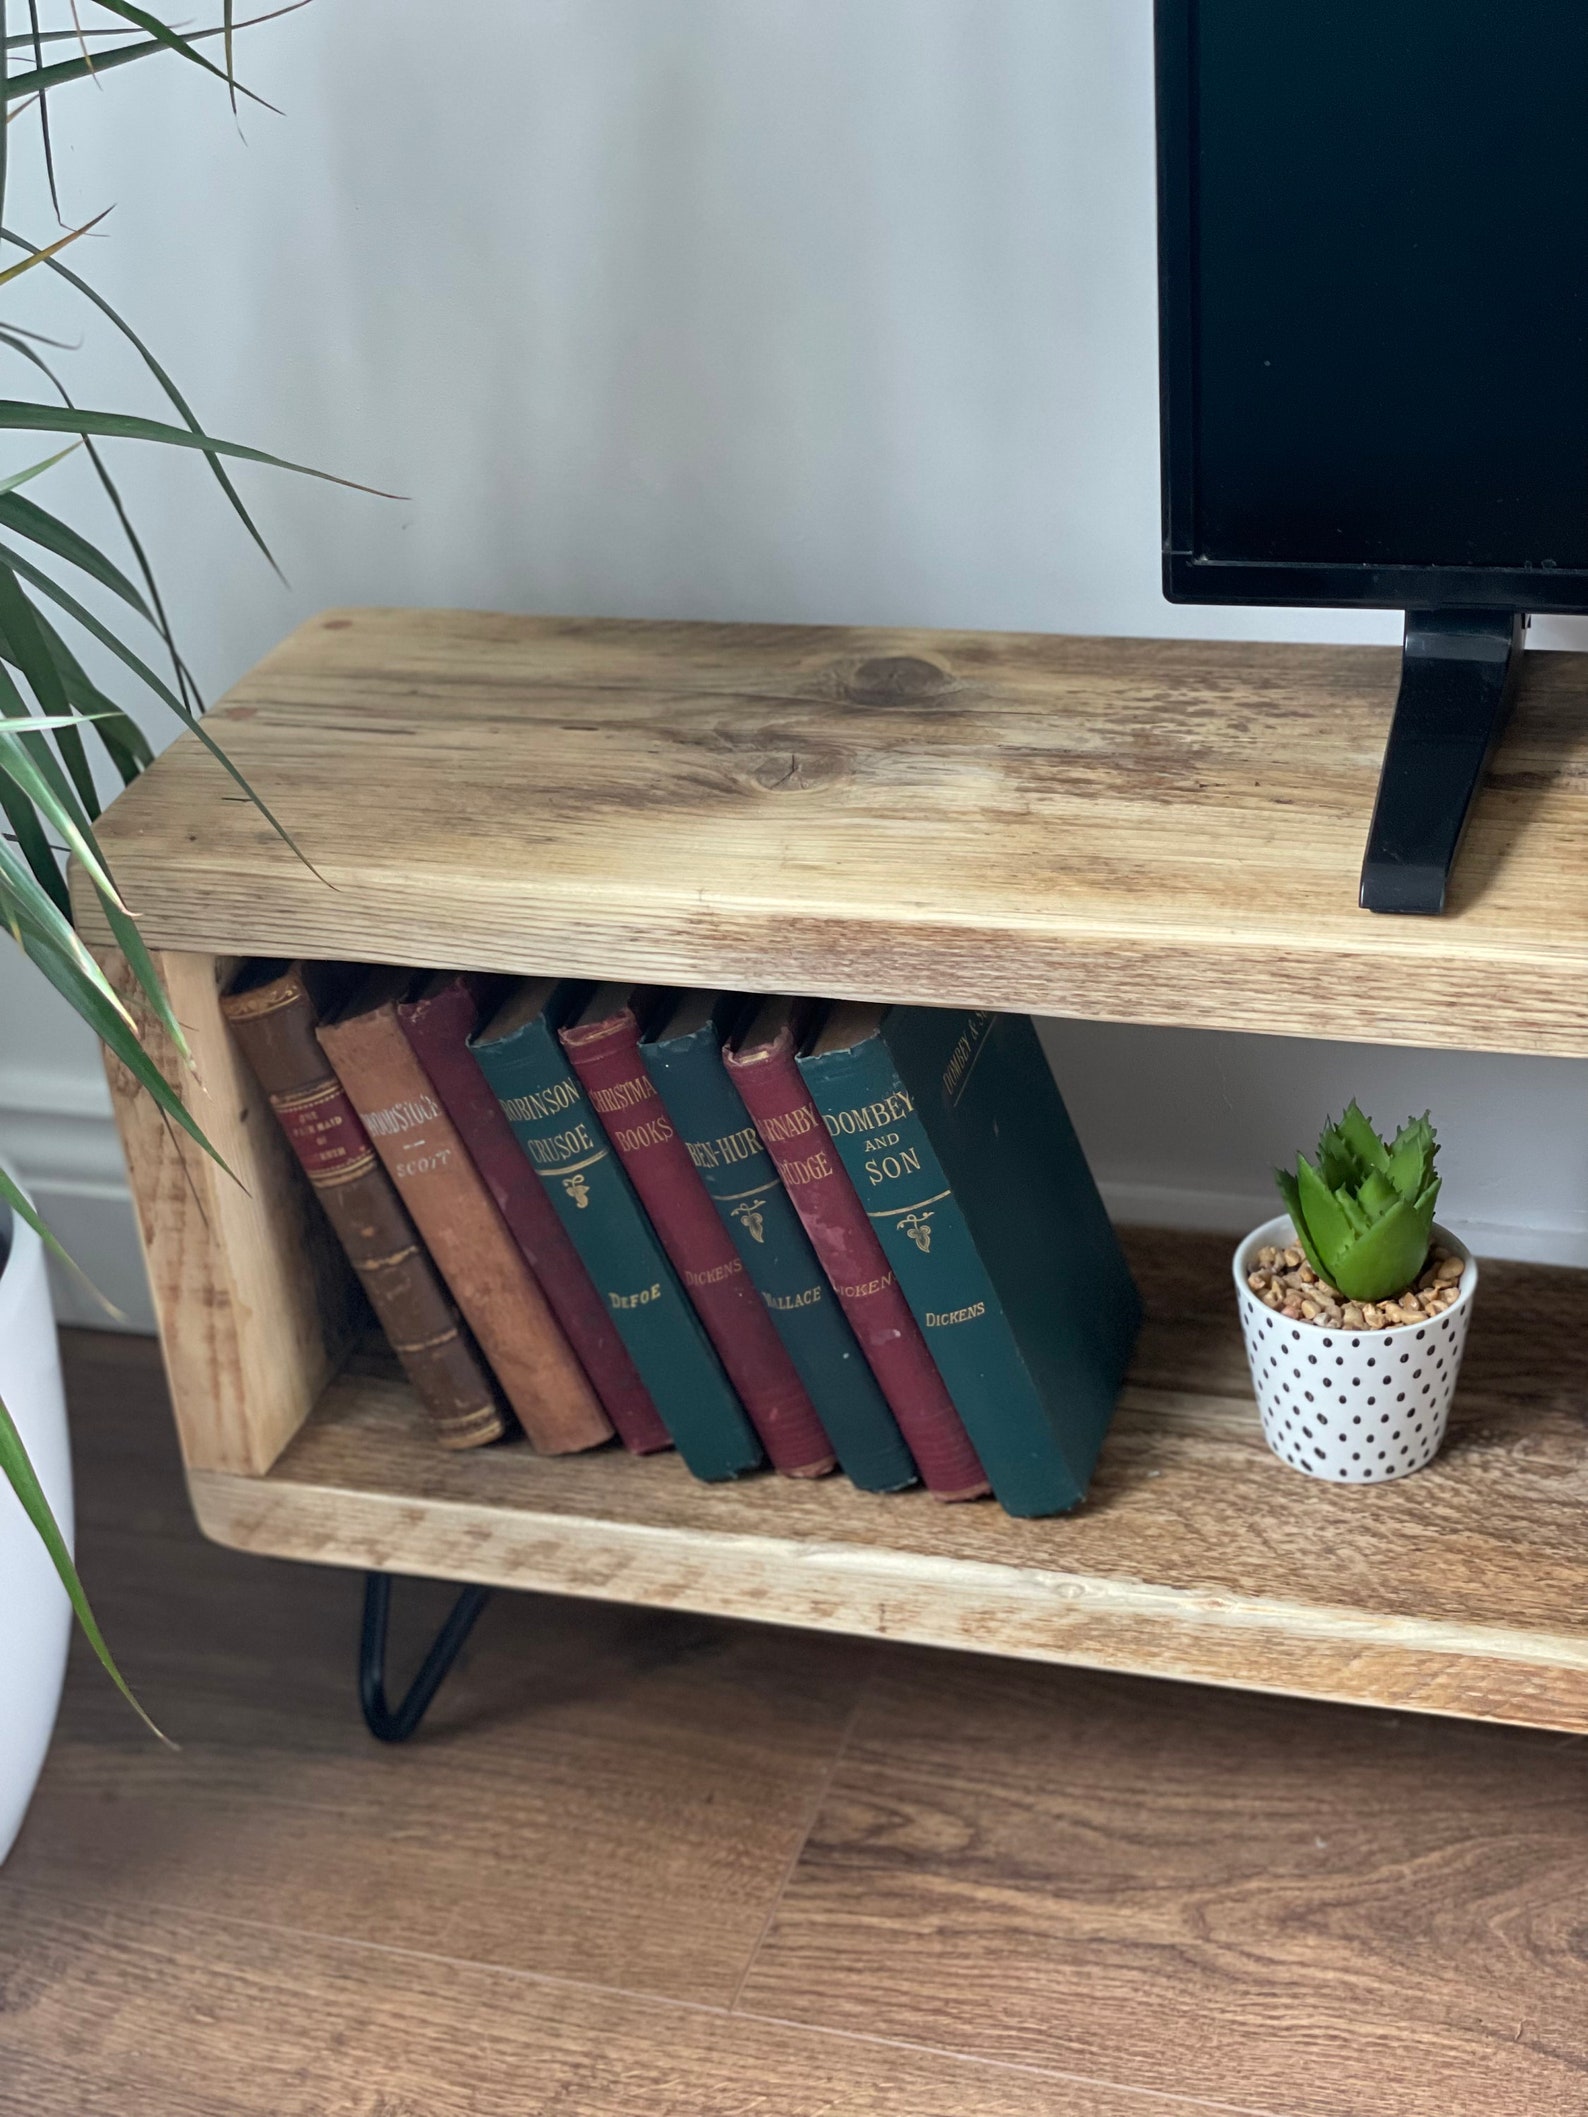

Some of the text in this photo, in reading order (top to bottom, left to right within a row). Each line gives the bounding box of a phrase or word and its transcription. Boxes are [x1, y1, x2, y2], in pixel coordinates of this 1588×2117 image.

[943, 1029, 971, 1095] DOMBEY
[498, 1076, 580, 1121] ROBINSON
[588, 1075, 657, 1113] CHRISTMA
[822, 1088, 914, 1136] DOMBEY
[615, 1115, 673, 1152] BOOKS
[757, 1103, 818, 1142] RNABY
[527, 1123, 594, 1163] CRUSOE
[685, 1127, 764, 1168] BEN-HUR
[864, 1132, 900, 1153] AND
[396, 1149, 451, 1178] SCOTT
[779, 1152, 833, 1185] RUDGE
[865, 1147, 921, 1186] SON
[685, 1258, 743, 1286] DICKENS
[837, 1270, 897, 1298] ICKEN
[608, 1283, 662, 1309] DEFOE
[761, 1285, 821, 1310] WALLACE
[925, 1302, 986, 1328] DICKENS
